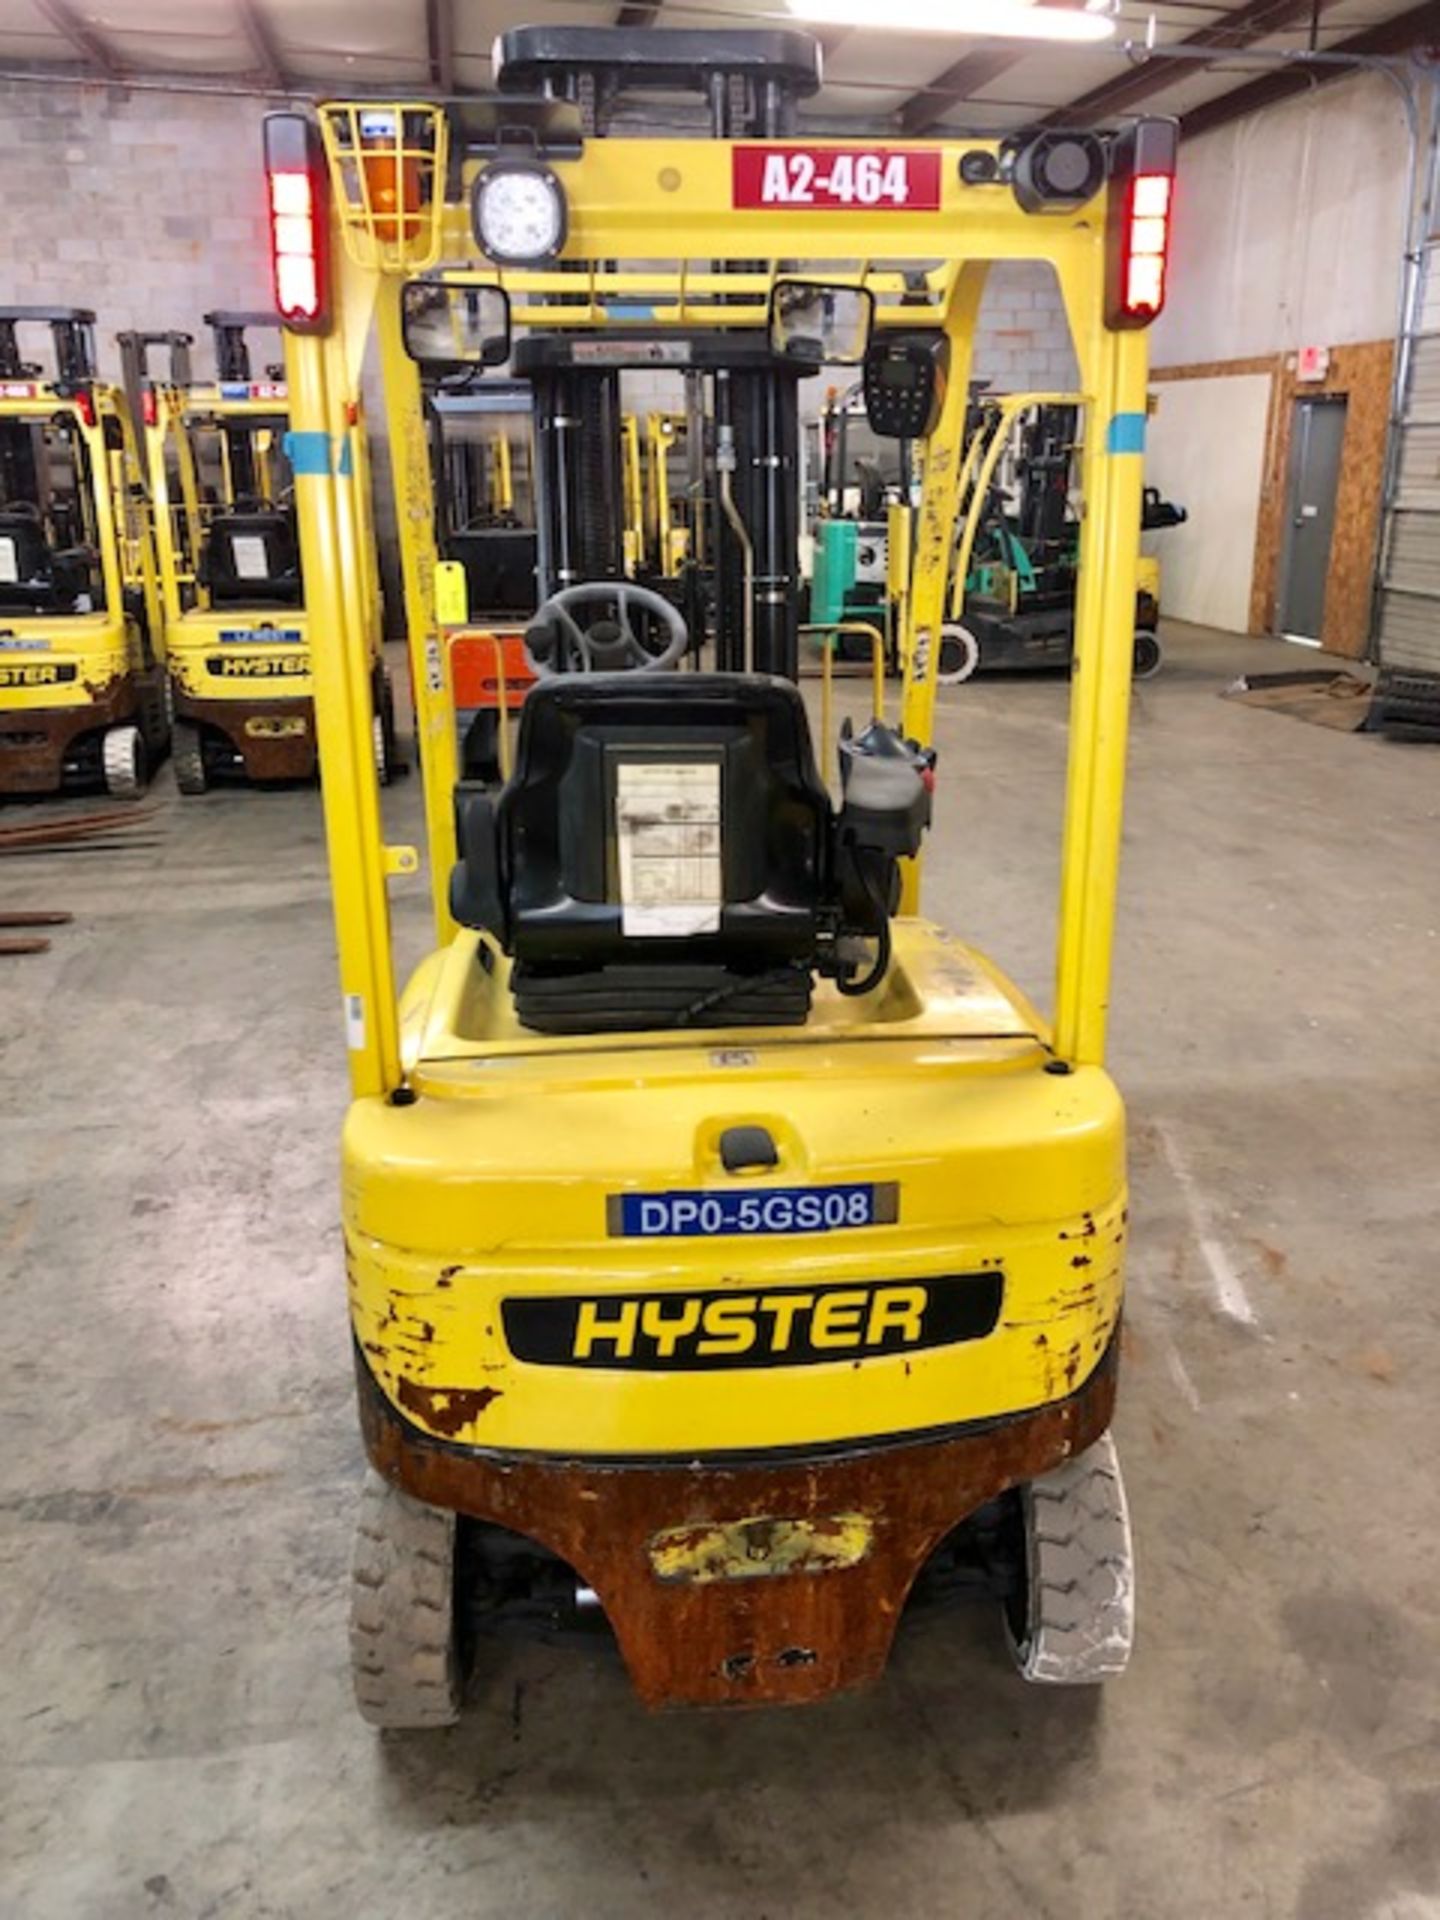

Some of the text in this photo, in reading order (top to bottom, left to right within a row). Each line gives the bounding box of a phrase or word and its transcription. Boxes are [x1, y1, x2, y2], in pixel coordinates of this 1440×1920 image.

[761, 154, 908, 203] A2-464
[640, 1193, 869, 1233] DP0-5GS08
[573, 1286, 927, 1358] HYSTER
